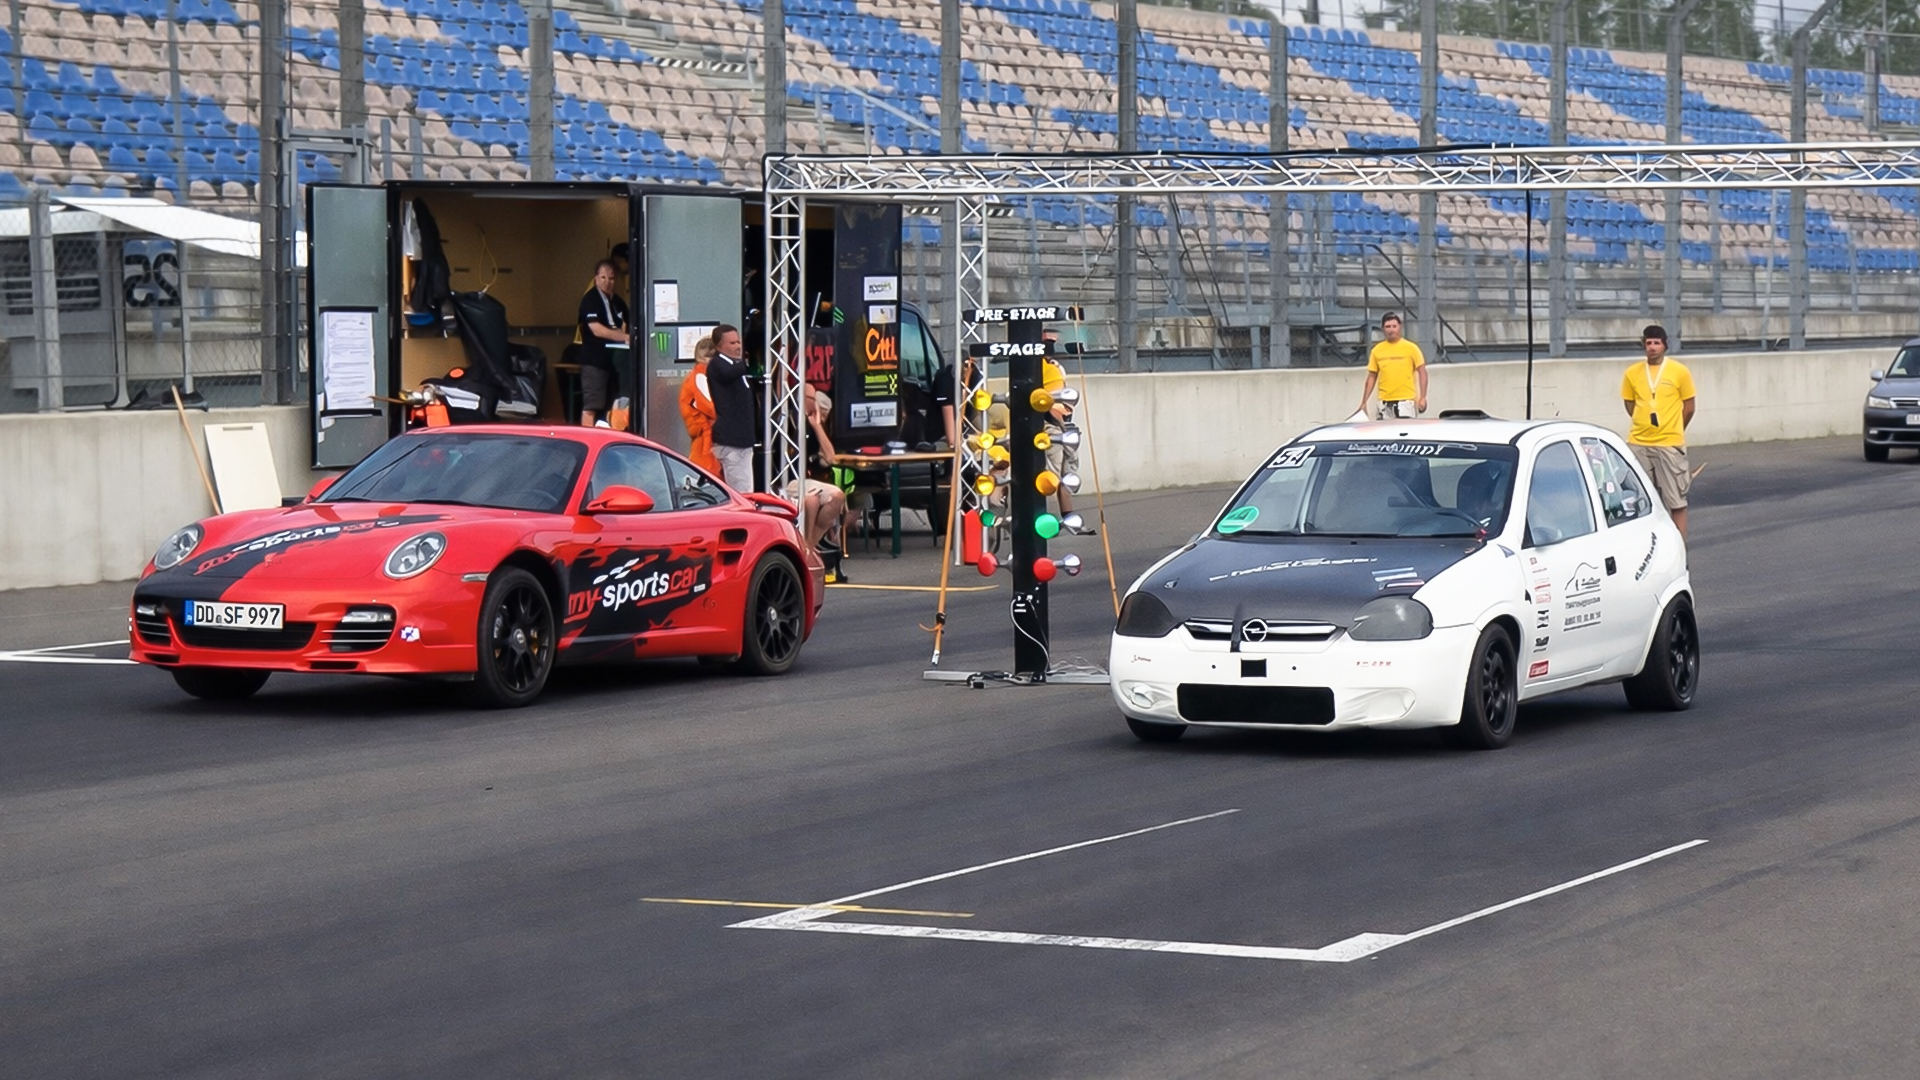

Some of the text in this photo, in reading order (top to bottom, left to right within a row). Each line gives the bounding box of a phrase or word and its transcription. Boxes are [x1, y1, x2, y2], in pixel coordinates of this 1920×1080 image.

[1272, 447, 1312, 466] 54
[195, 604, 280, 625] DD SF 997
